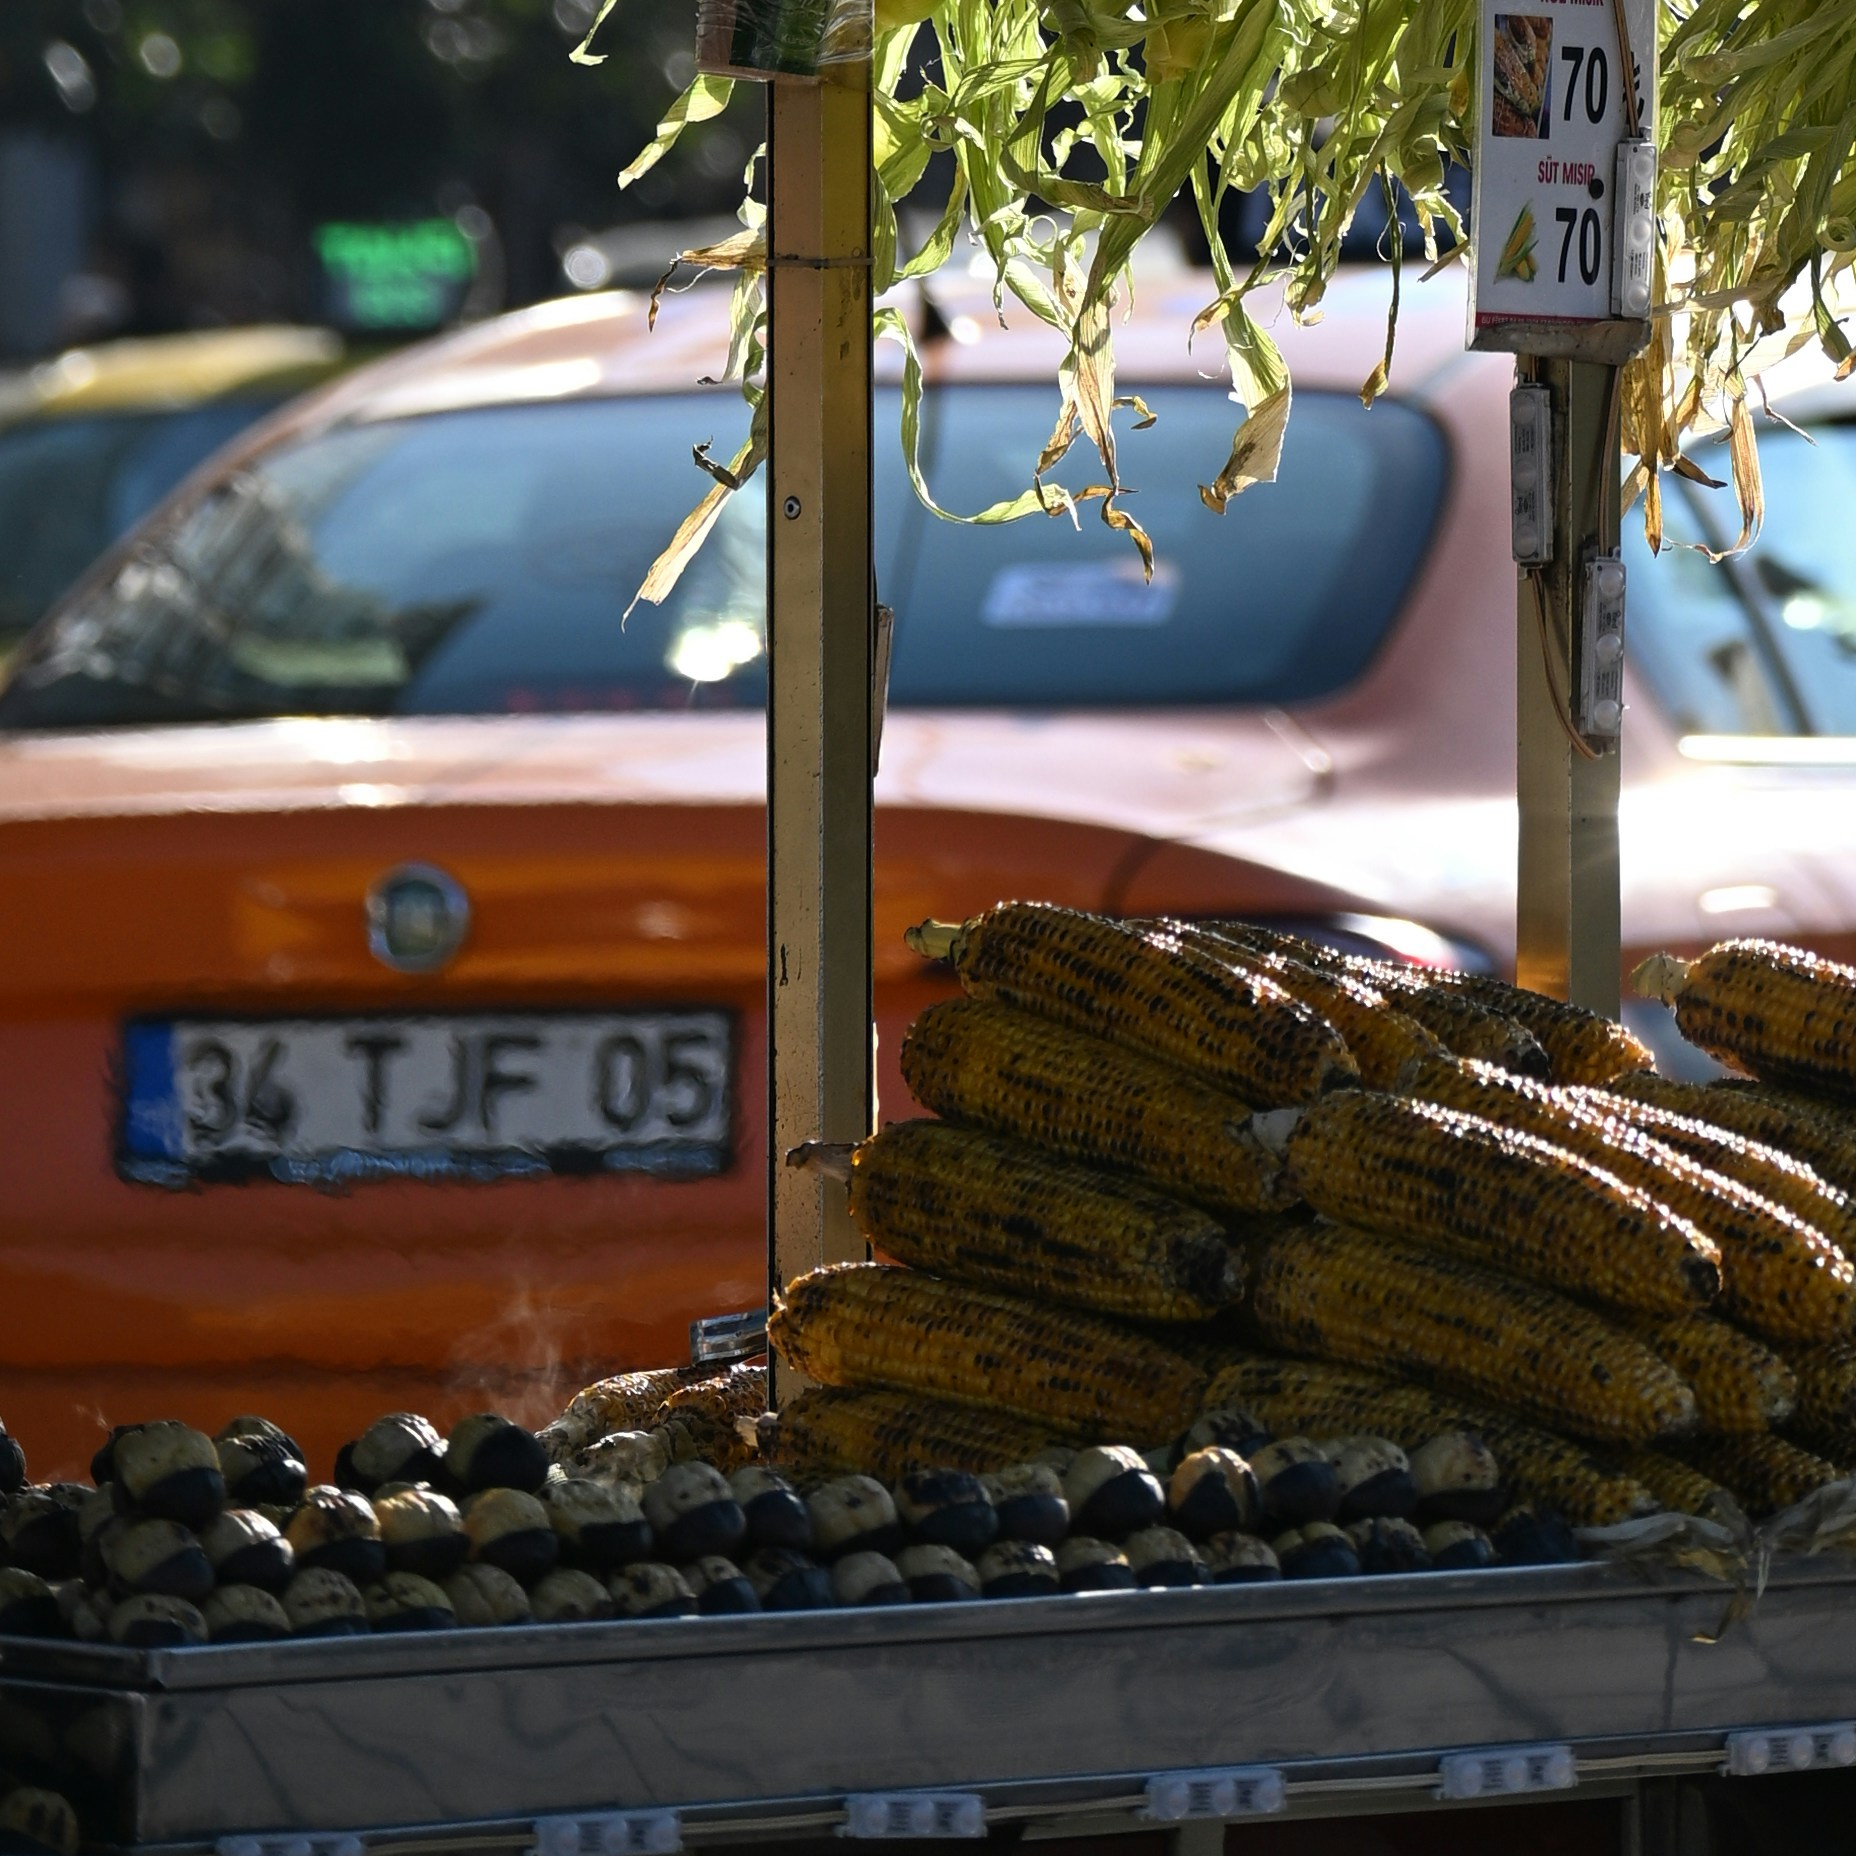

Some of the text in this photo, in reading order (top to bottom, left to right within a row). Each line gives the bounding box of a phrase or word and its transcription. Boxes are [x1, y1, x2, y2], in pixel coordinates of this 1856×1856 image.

[1562, 46, 1608, 124] 70
[1538, 155, 1595, 186] SÜT MISIR
[1556, 207, 1601, 285] 70
[346, 1031, 545, 1136] TJF
[598, 1031, 716, 1128] 05
